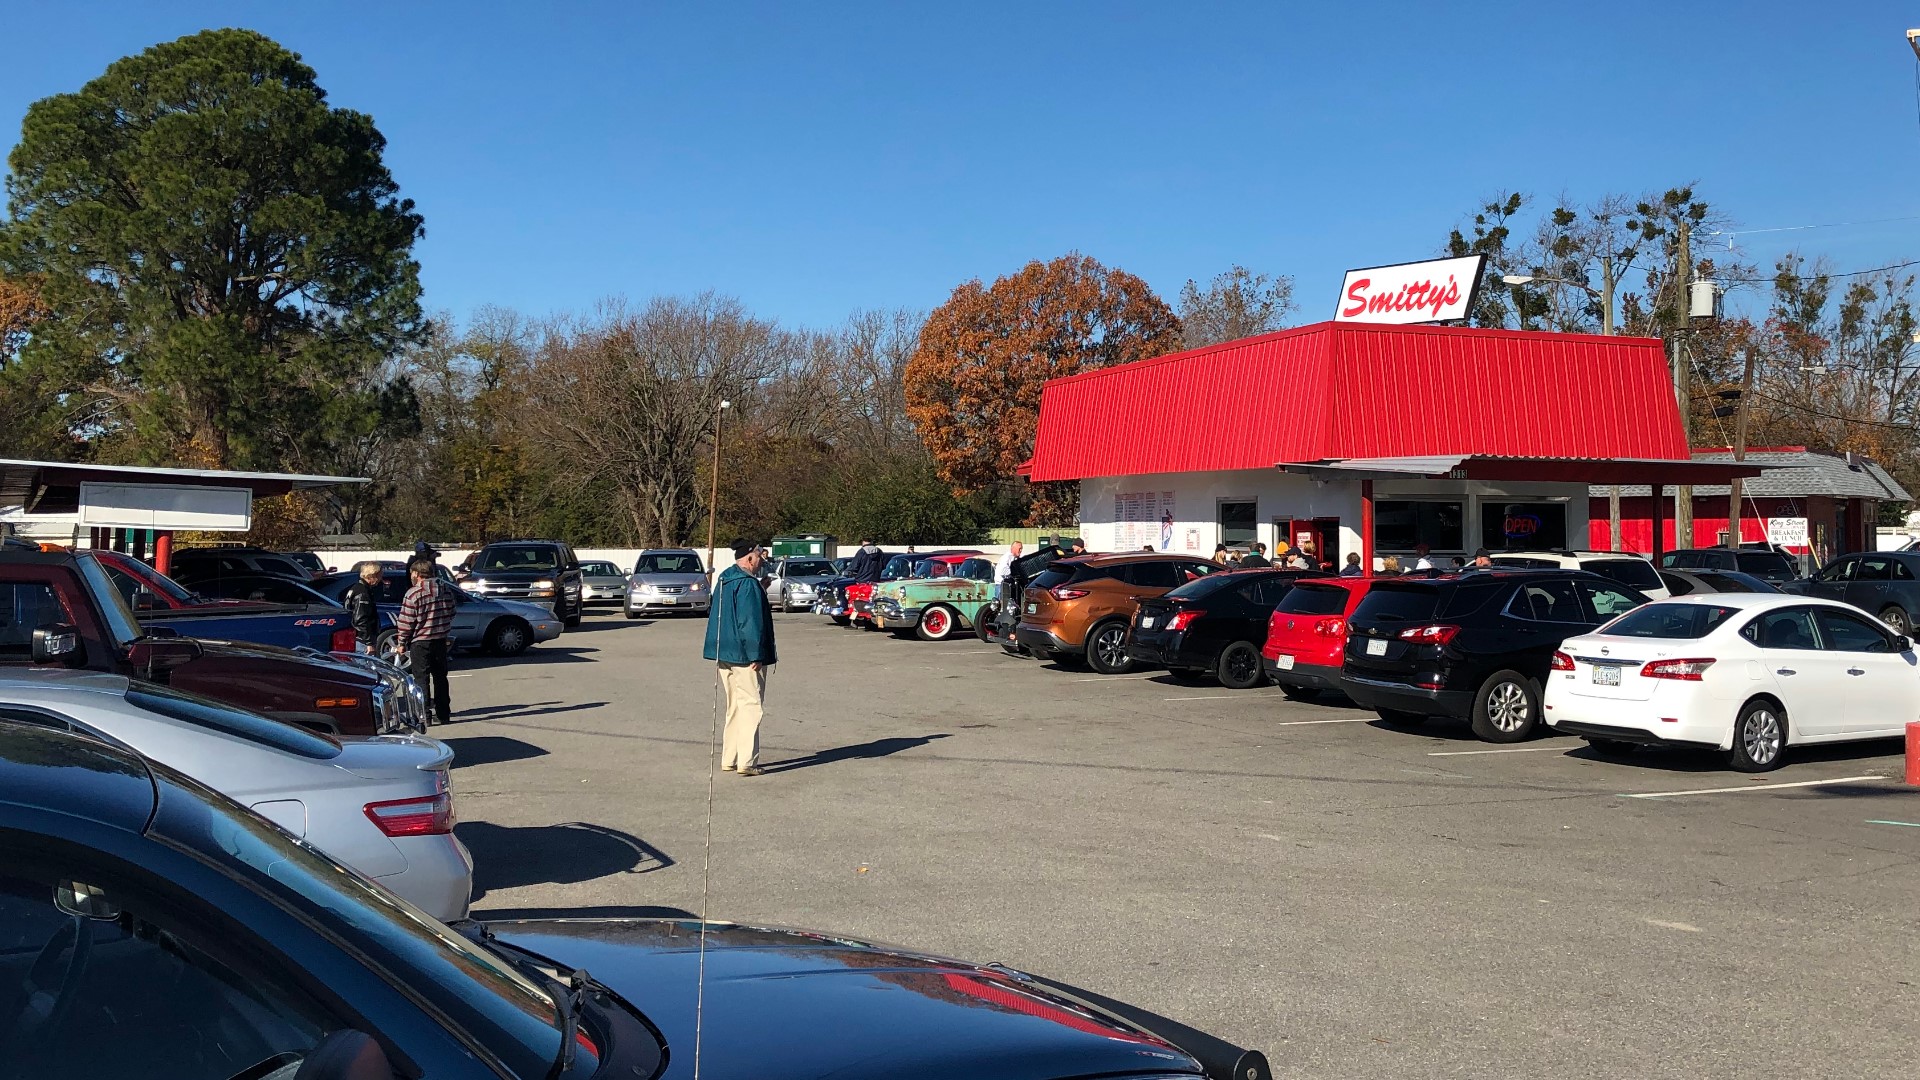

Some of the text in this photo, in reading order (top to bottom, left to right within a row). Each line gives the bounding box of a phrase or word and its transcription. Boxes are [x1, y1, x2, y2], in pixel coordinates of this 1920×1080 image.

[1343, 274, 1461, 318] Smitty's
[1503, 517, 1537, 533] OPEN
[1770, 519, 1783, 528] King
